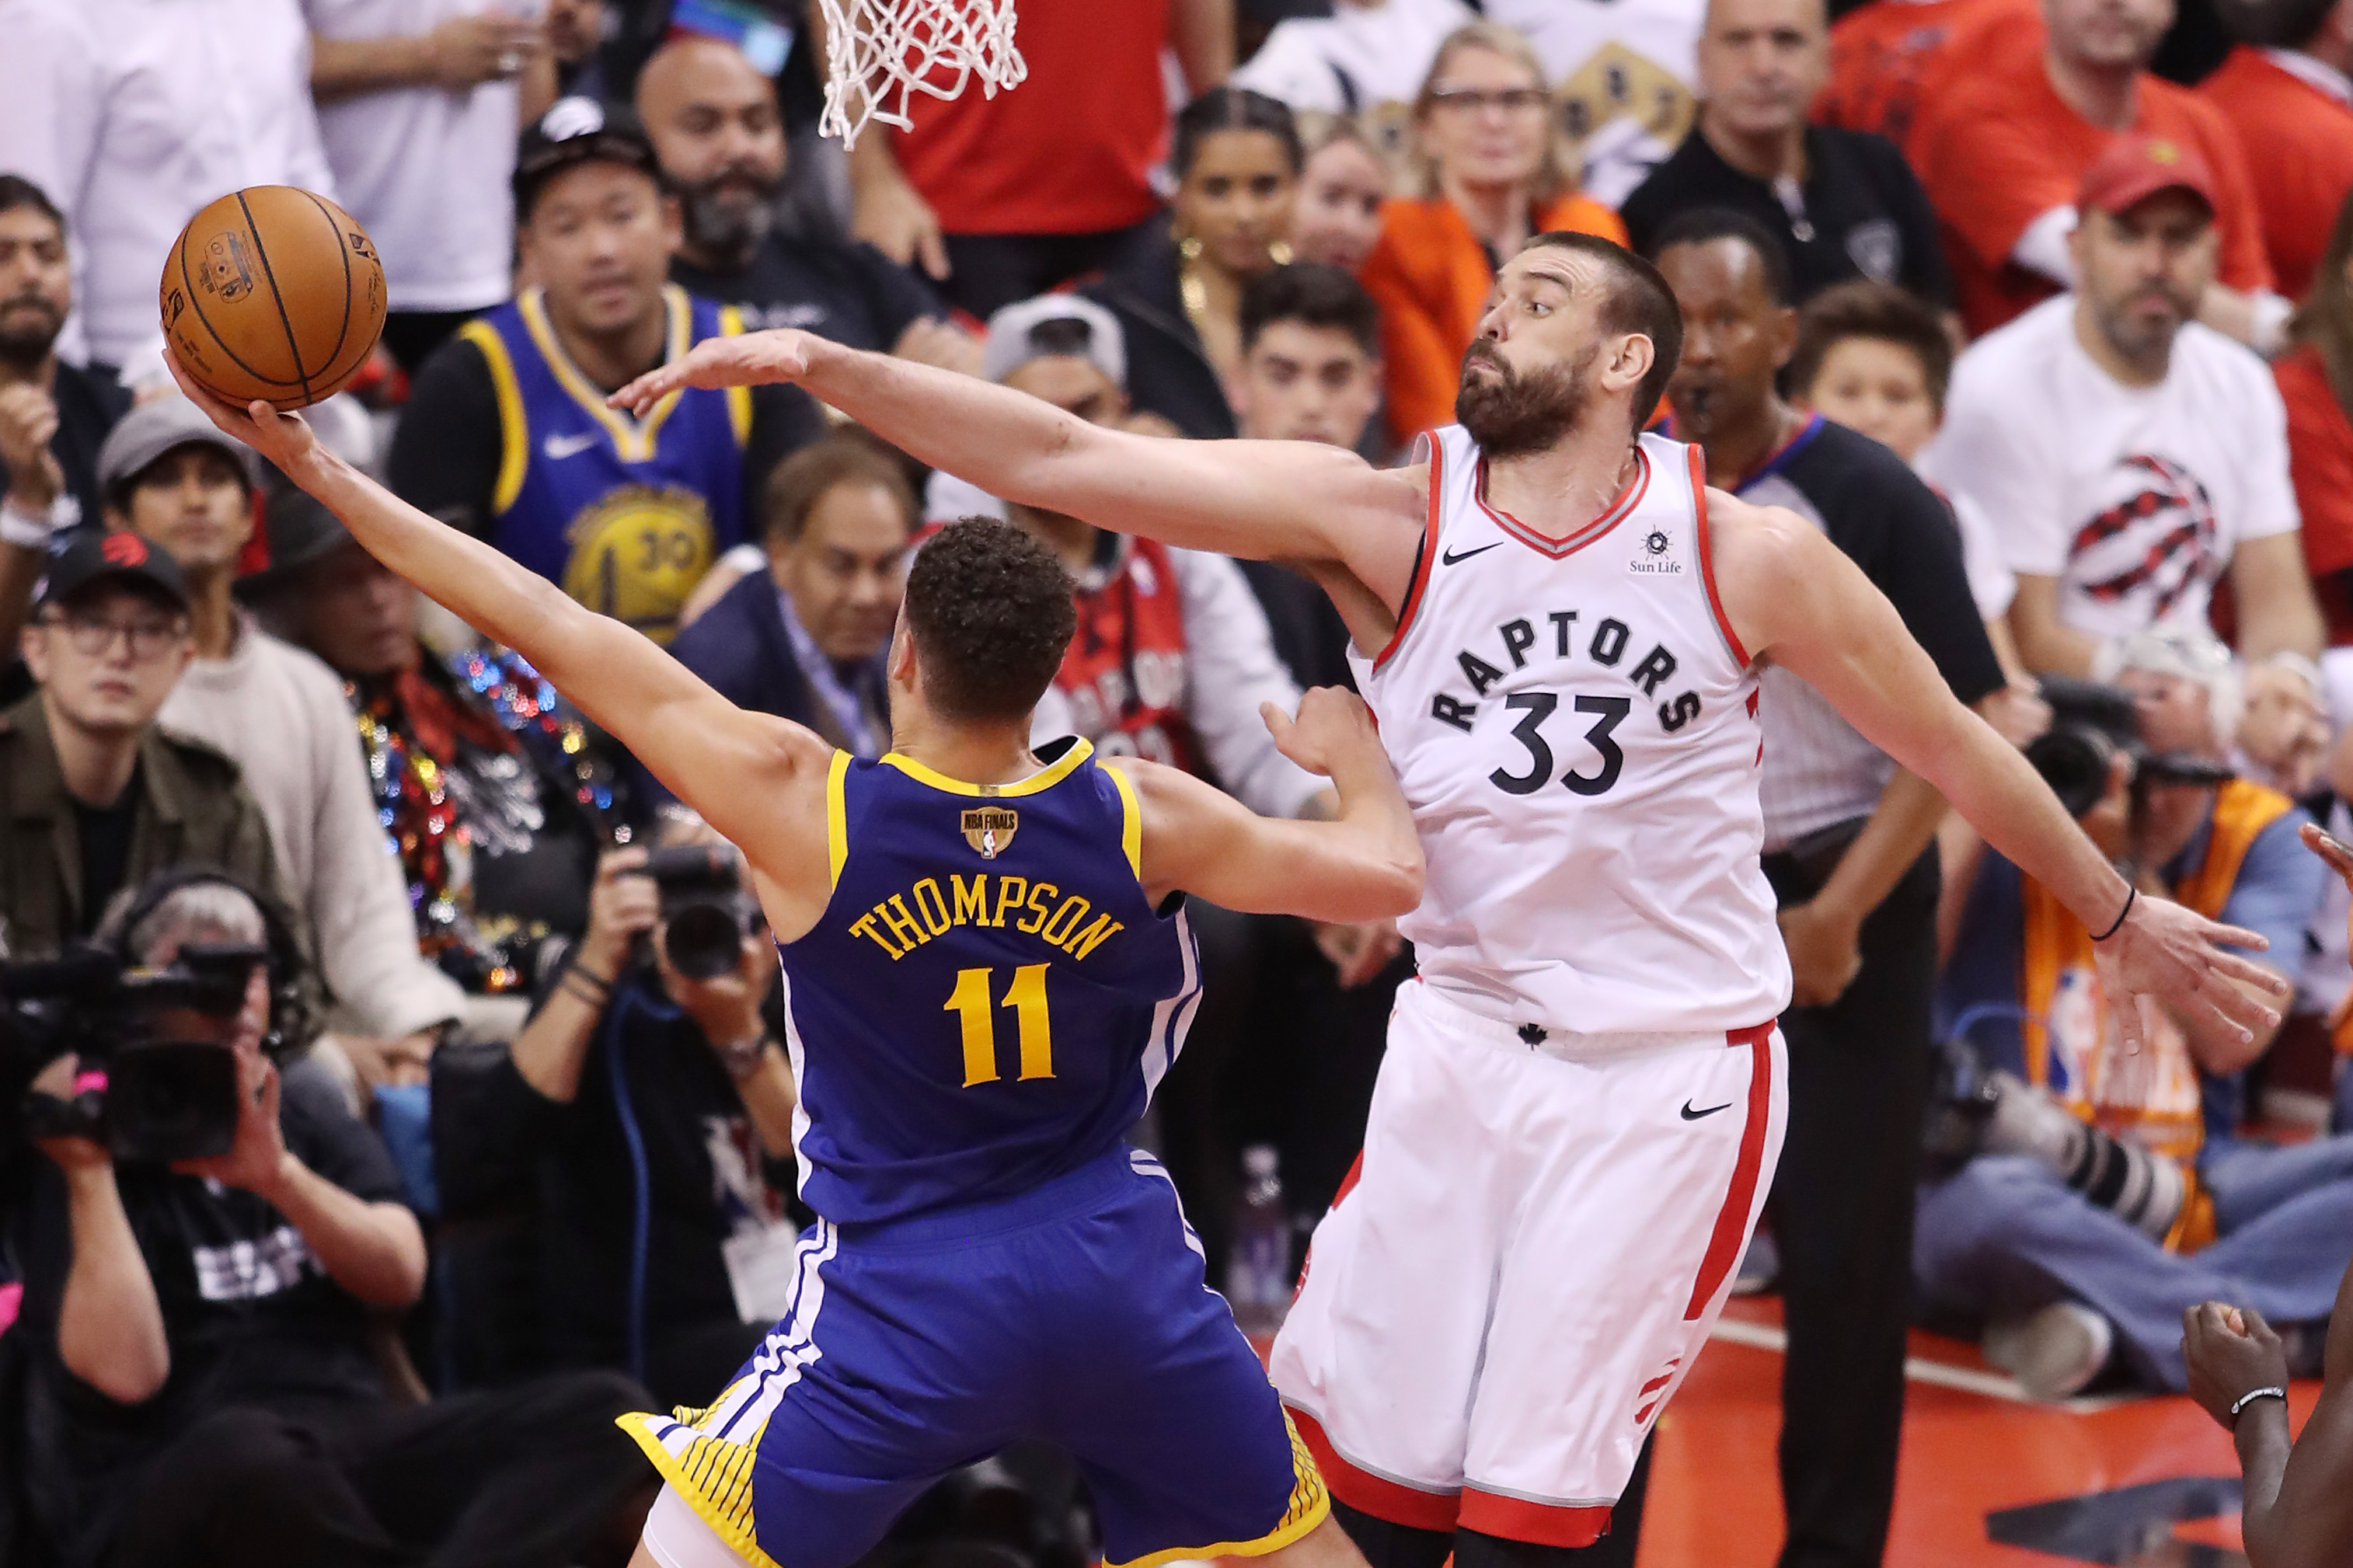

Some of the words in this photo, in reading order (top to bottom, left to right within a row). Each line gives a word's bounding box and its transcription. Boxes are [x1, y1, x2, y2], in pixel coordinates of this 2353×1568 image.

[1630, 560, 1654, 572] Sun
[1658, 561, 1682, 573] Life
[1431, 609, 1703, 736] RAPTORS
[1488, 692, 1631, 796] 33
[964, 814, 983, 830] NBA
[985, 813, 1015, 830] FINALS
[848, 873, 1125, 961] THOMPSON
[943, 962, 1057, 1089] 11
